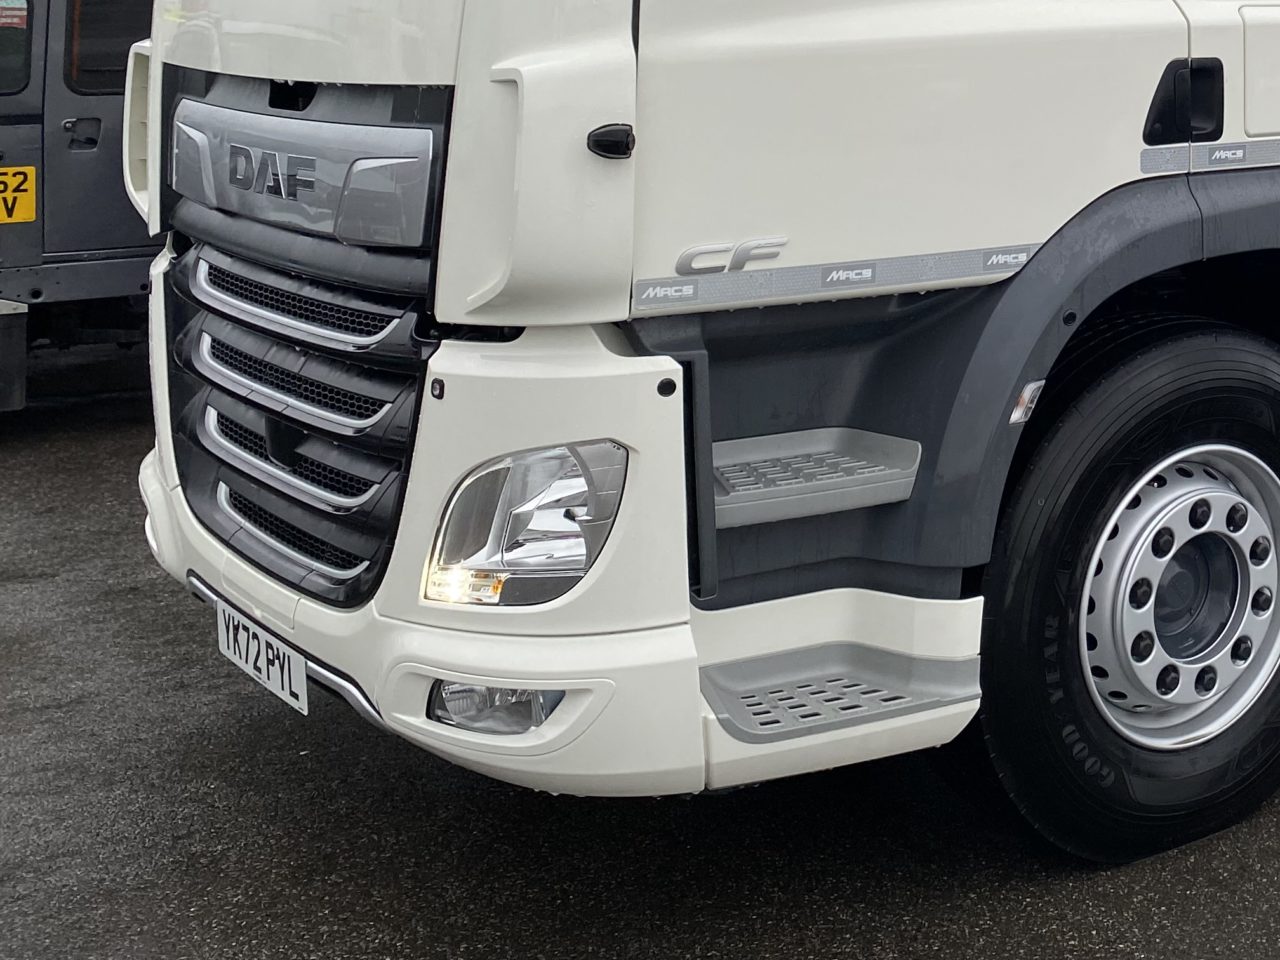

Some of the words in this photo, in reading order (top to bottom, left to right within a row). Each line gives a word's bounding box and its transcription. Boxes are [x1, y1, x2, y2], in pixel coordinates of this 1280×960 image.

[1211, 149, 1244, 160] MACS
[229, 143, 317, 201] DAF
[675, 235, 789, 276] CF
[987, 252, 1027, 265] MACS
[826, 268, 872, 282] MACS
[641, 285, 694, 299] MACS
[222, 608, 262, 674] YK72
[265, 639, 299, 702] PYL
